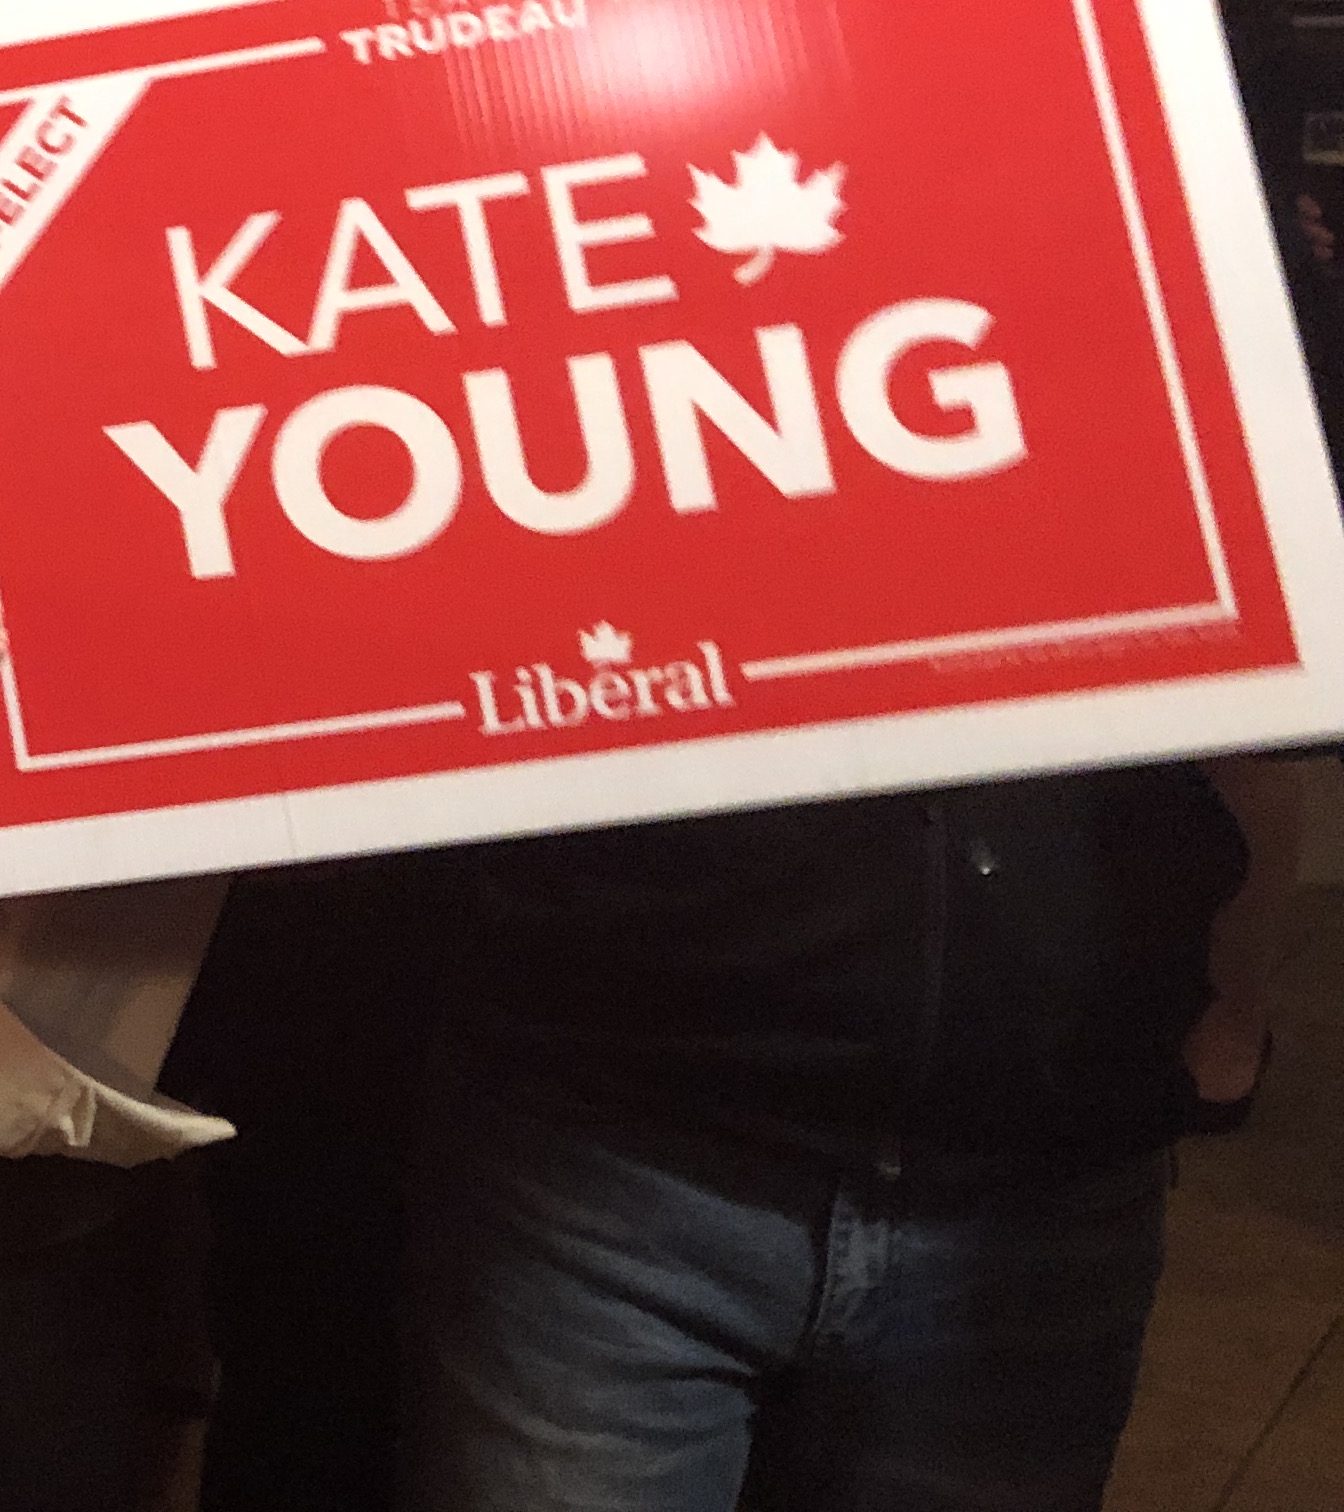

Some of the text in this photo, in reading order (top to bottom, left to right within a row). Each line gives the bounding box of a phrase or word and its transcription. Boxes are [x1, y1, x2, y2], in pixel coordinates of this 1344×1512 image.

[165, 152, 680, 371] KATE
[103, 295, 1029, 579] YOUNG
[468, 643, 736, 737] Liberal
